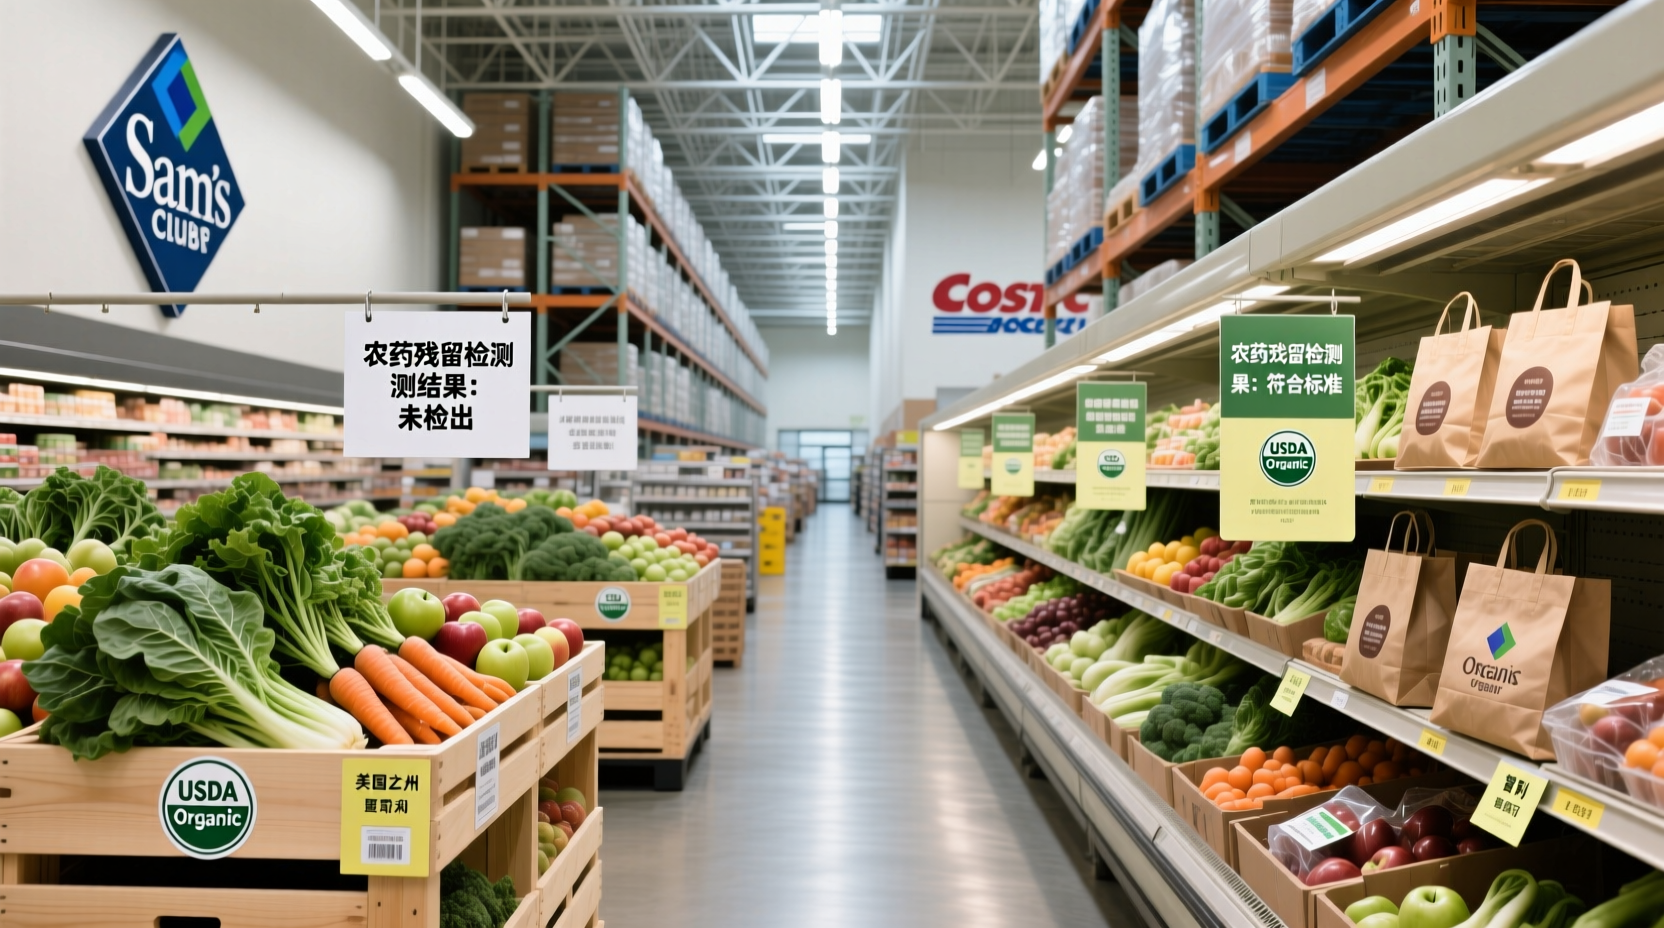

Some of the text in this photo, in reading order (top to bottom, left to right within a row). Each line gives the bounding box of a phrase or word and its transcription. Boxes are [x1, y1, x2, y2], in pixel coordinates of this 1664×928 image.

[125, 113, 231, 229] Sam's
[363, 340, 514, 368] 农药残留检测
[1230, 372, 1343, 395] 果：符合标准
[398, 403, 474, 431] 未检出
[1269, 441, 1308, 455] USDA
[1265, 458, 1309, 470] Organic
[178, 779, 239, 802] USDA
[173, 807, 242, 831] Organic
